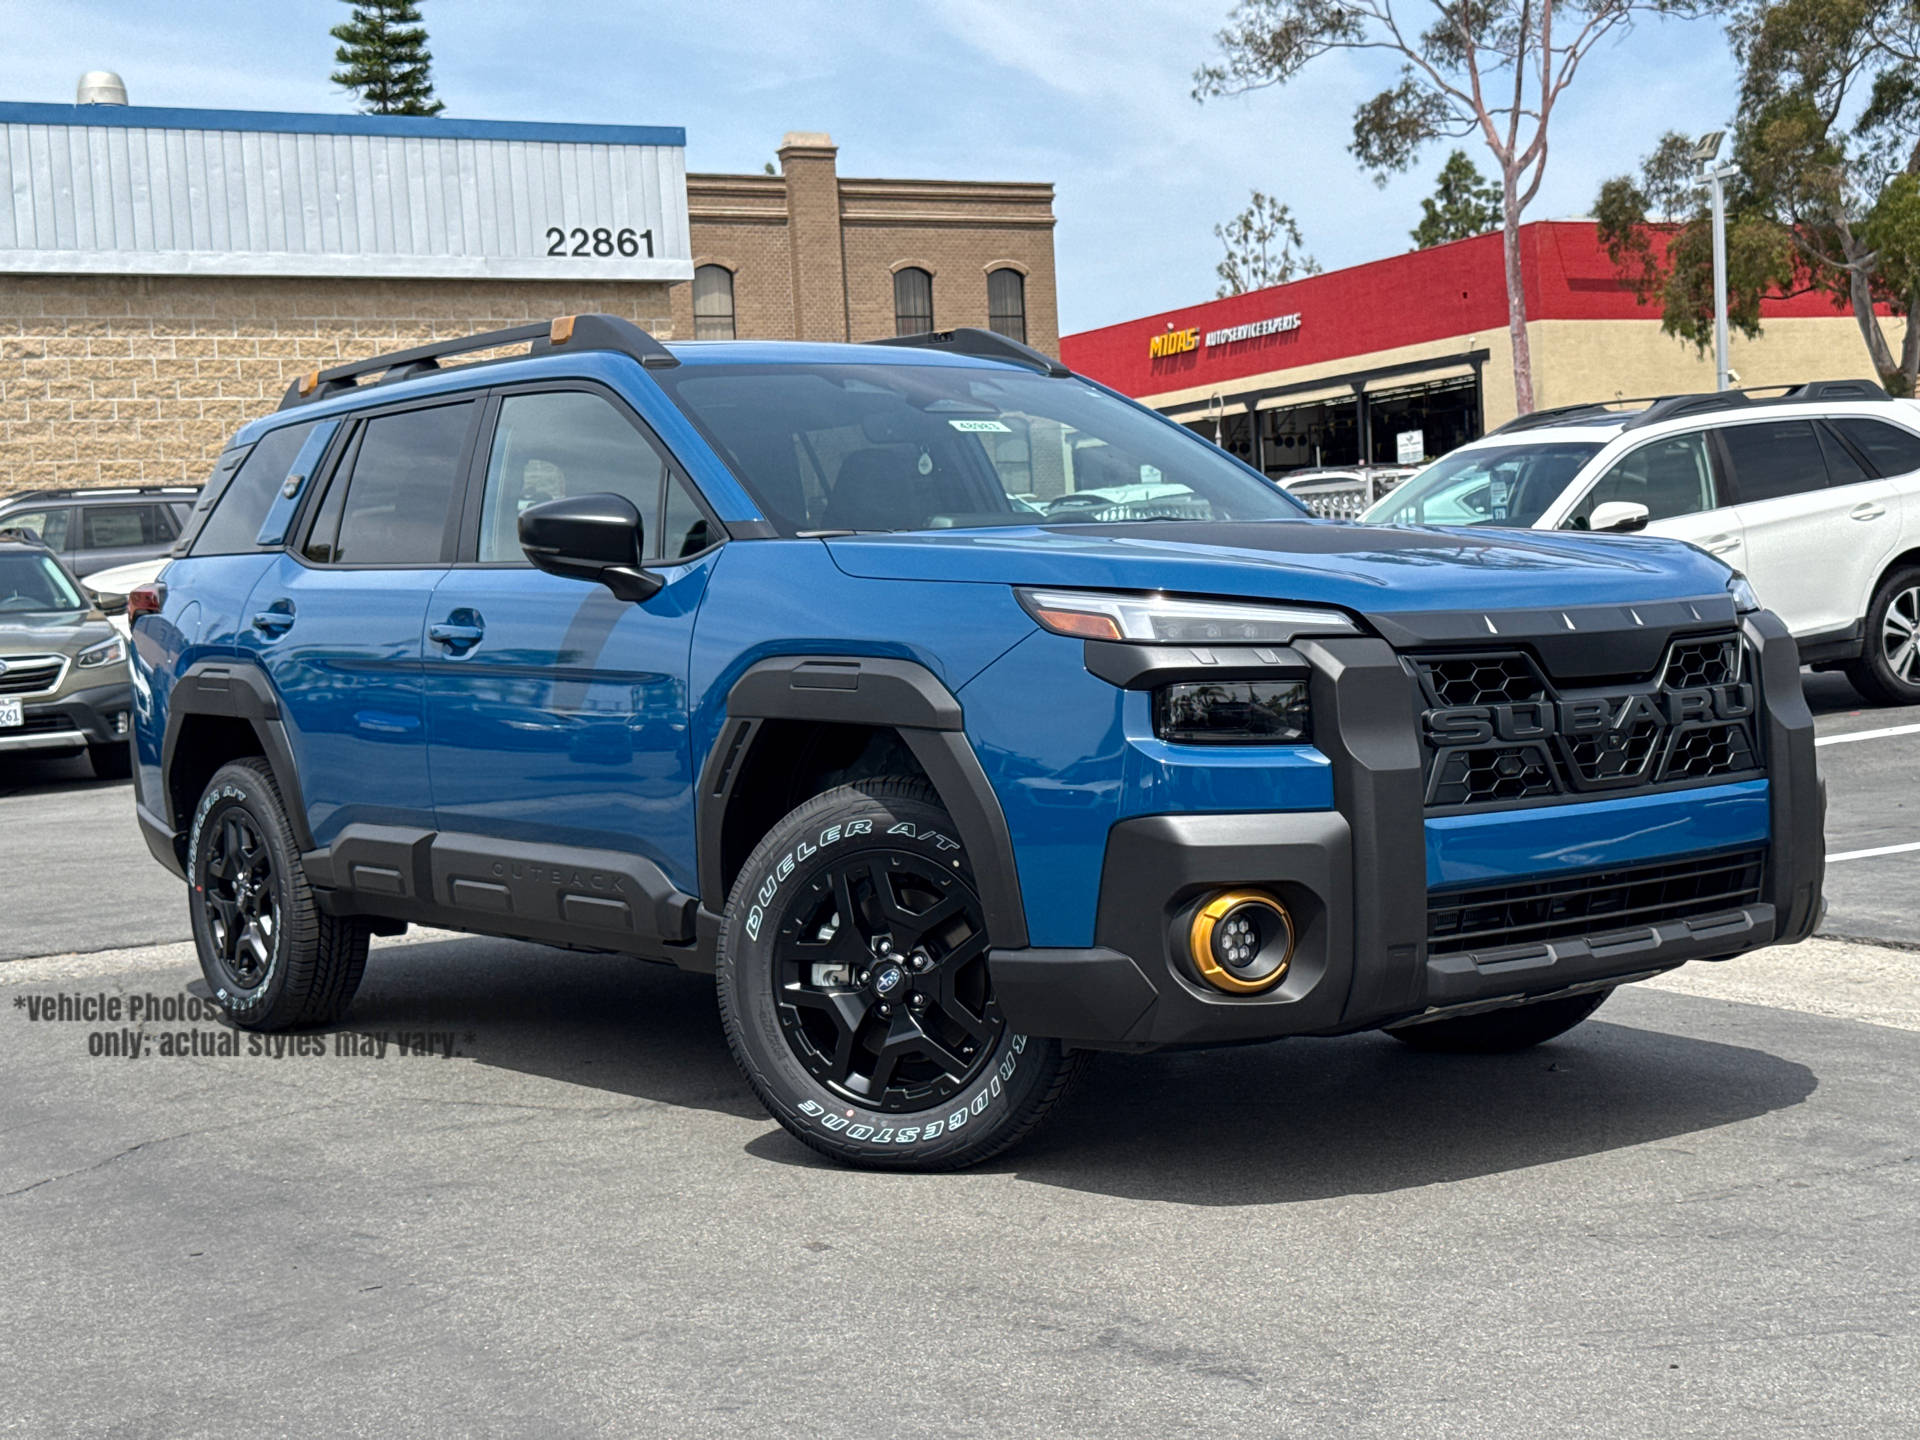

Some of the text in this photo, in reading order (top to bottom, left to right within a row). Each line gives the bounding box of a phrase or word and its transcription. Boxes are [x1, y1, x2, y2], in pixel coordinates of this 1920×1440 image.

[545, 226, 655, 259] 22861
[1149, 311, 1302, 359] MIDAS AUTO SERVICE EXPERTS
[1421, 682, 1755, 747] SUBARU
[491, 861, 626, 893] OUTBACK
[745, 818, 961, 942] DUELER A/T
[797, 1034, 1029, 1143] BRIDGESTONE
